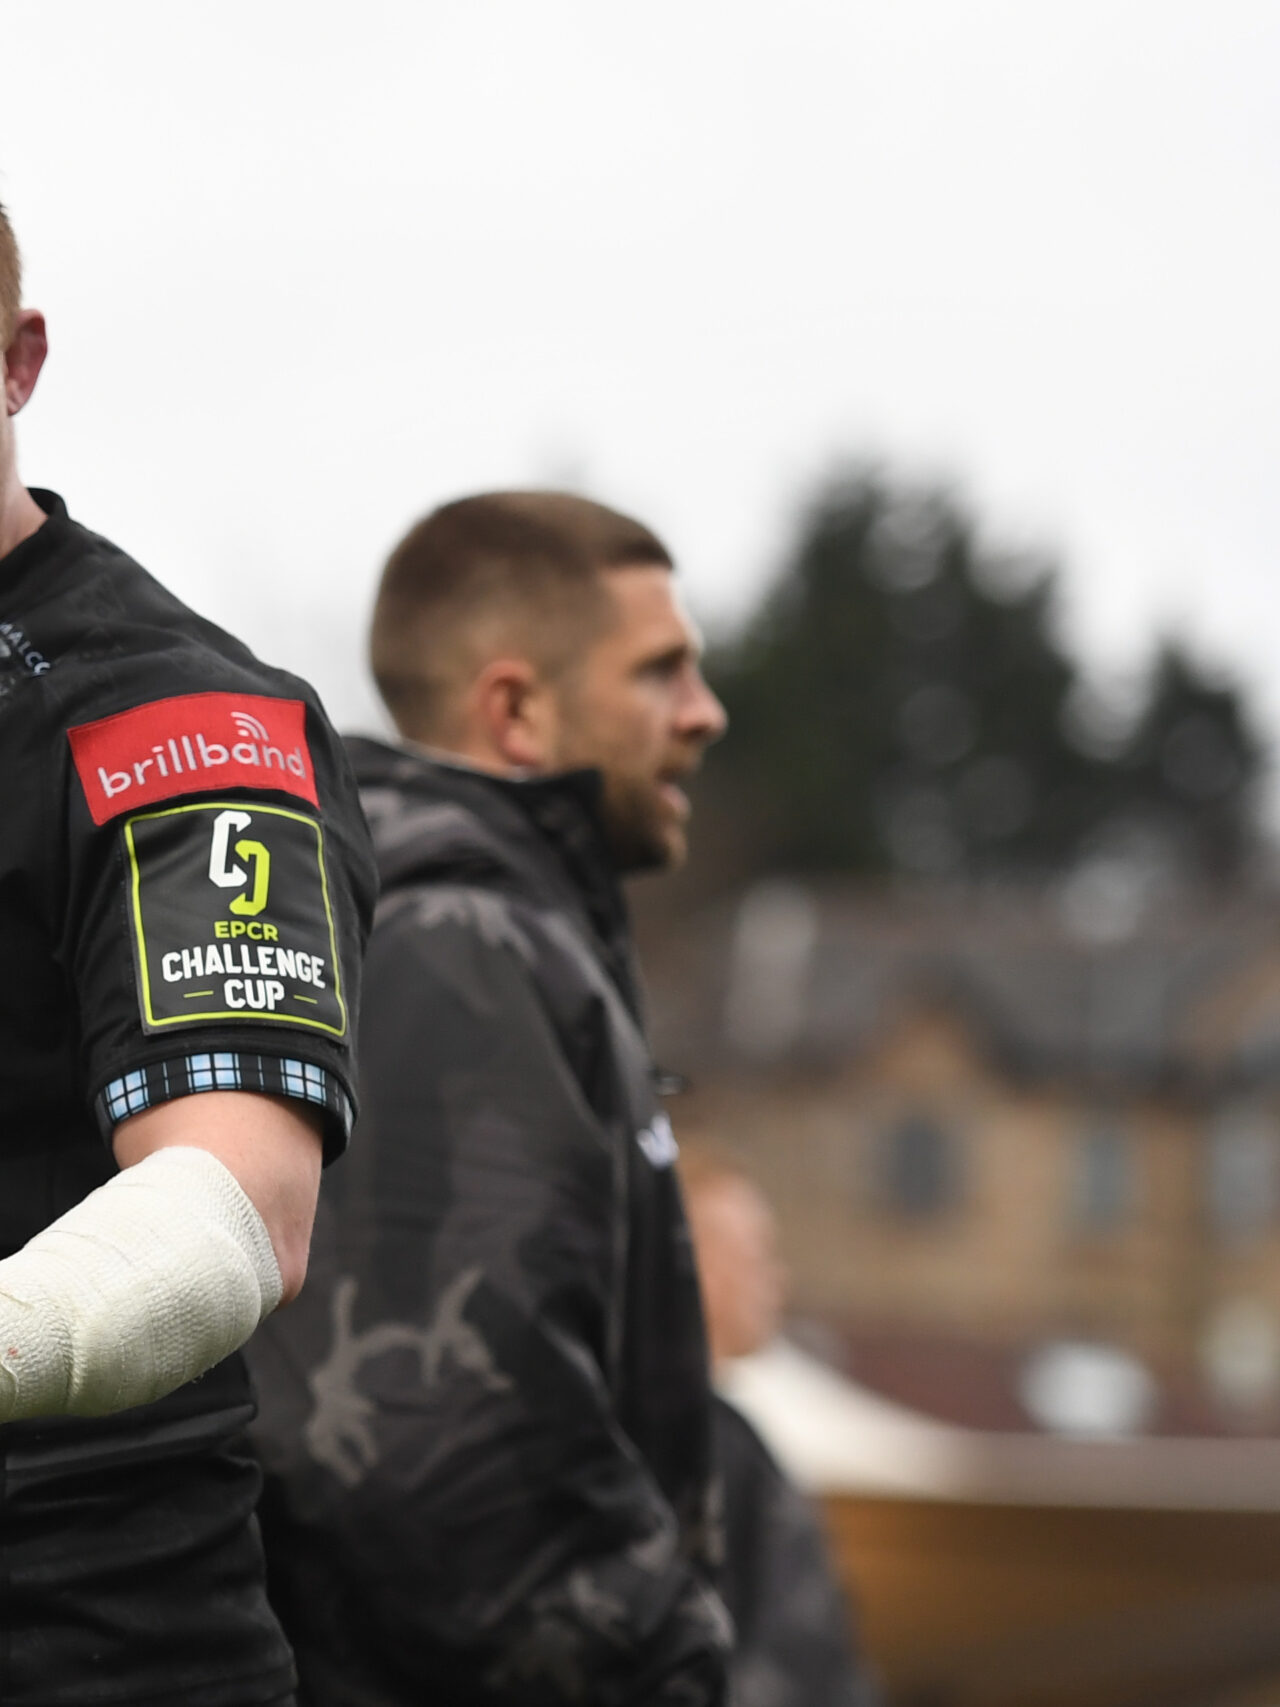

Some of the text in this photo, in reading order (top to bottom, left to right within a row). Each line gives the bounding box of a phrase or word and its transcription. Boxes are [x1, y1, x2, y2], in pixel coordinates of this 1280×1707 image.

[97, 733, 306, 798] brillband
[214, 921, 279, 941] EPCR
[161, 943, 326, 989] CHALLENGE
[223, 979, 285, 1010] CUP
